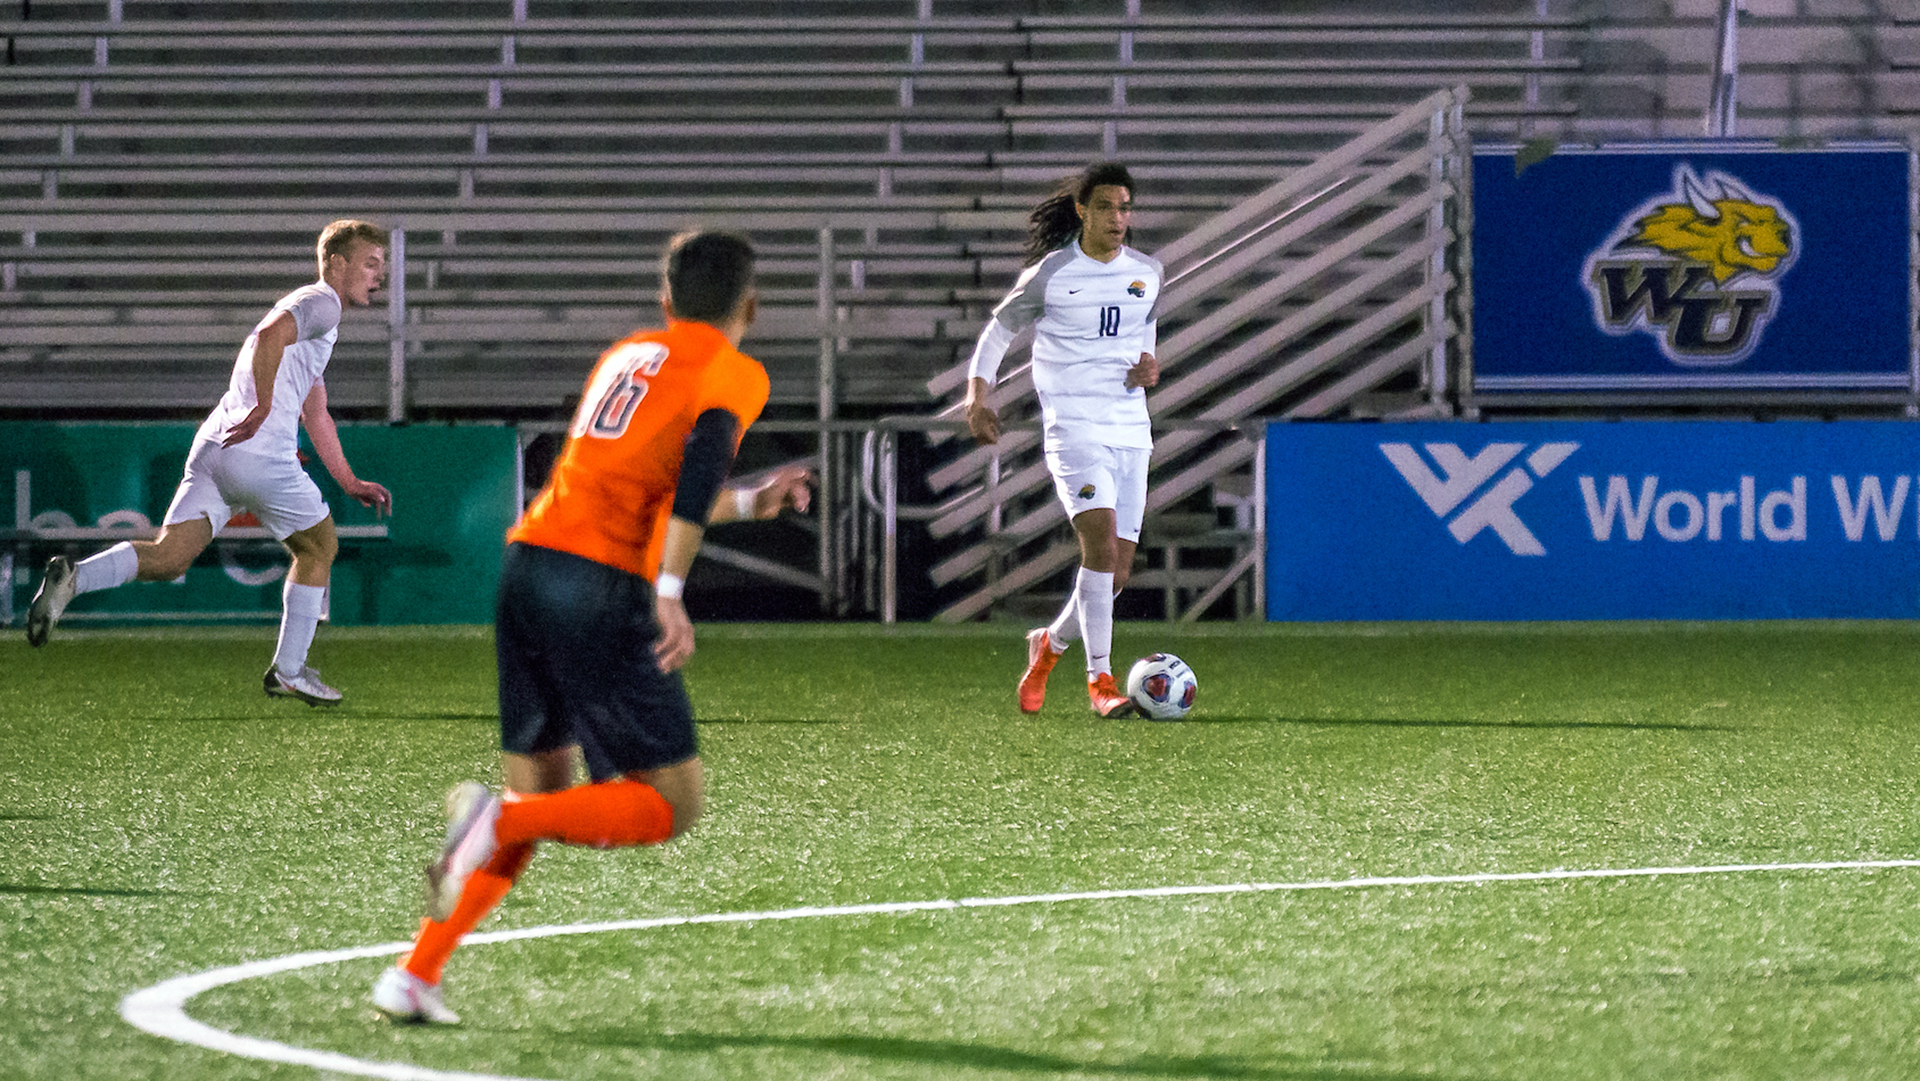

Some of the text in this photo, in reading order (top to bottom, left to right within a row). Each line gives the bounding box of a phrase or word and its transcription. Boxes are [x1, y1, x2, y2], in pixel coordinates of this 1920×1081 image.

[1099, 306, 1120, 337] 10
[1592, 260, 1772, 356] WU
[1578, 475, 1808, 542] World
[1830, 475, 1920, 542] W
